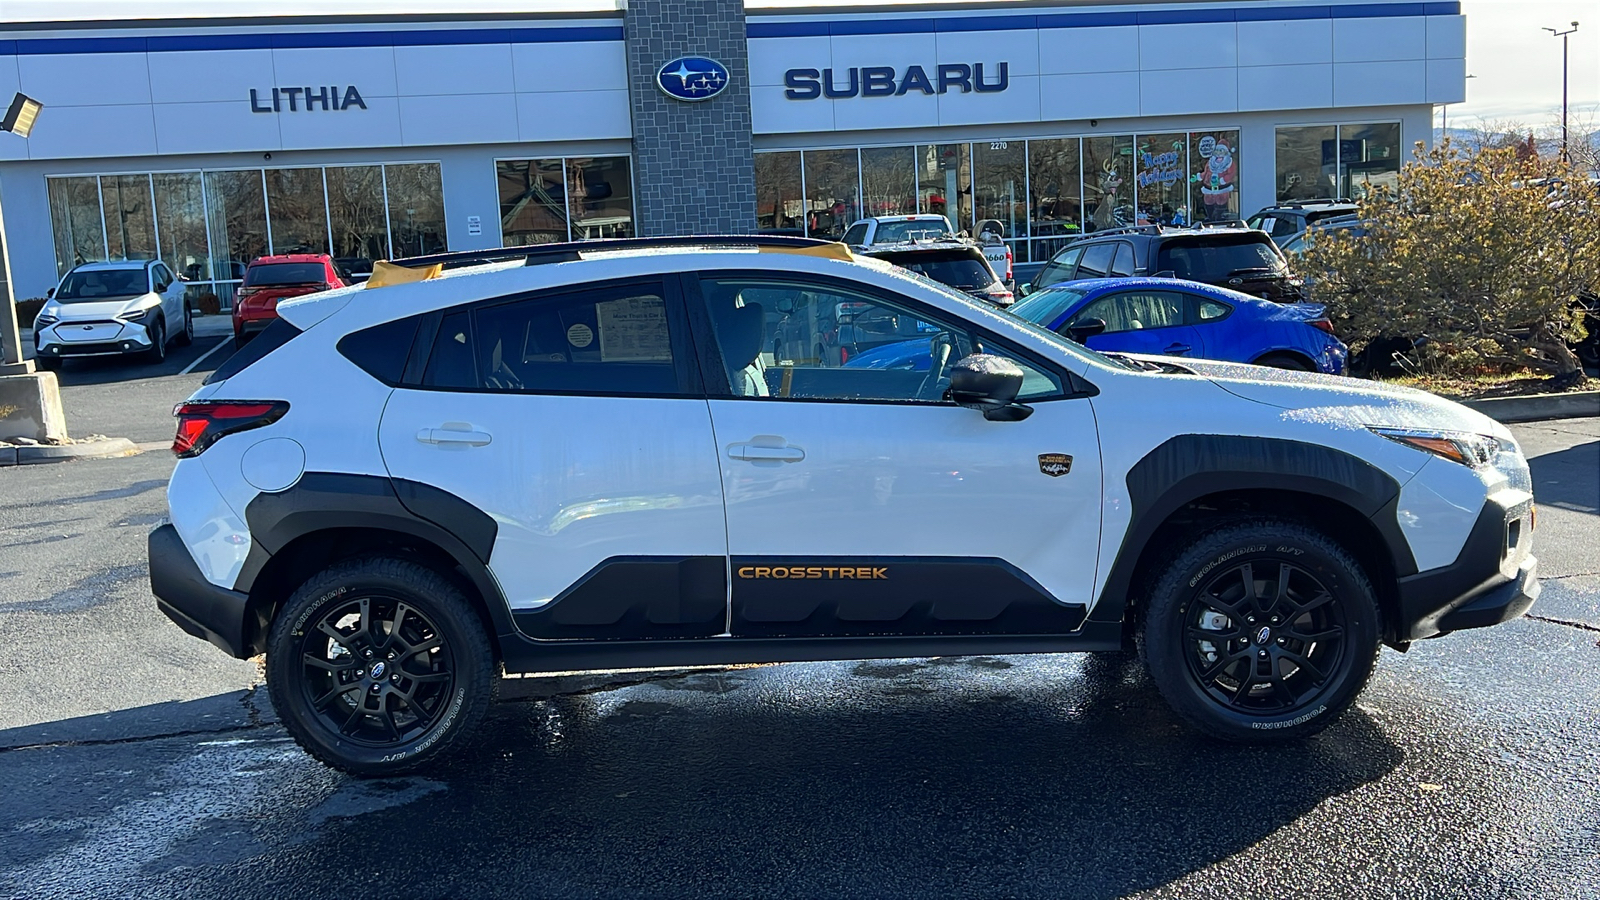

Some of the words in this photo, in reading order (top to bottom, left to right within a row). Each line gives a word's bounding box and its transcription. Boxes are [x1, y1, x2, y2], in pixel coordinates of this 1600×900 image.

[785, 62, 1008, 99] SUBARU
[249, 86, 367, 113] LITHIA
[990, 142, 1007, 150] 2270
[1141, 151, 1178, 169] Happy
[1137, 167, 1184, 188] Holidays
[738, 567, 889, 579] CROSSTREK
[1189, 544, 1267, 588] GEOLANDAR
[1276, 544, 1305, 556] A/T
[291, 586, 347, 637] YOKOHAMA
[1252, 704, 1327, 730] YOKOHAMA
[381, 751, 407, 763] A/T
